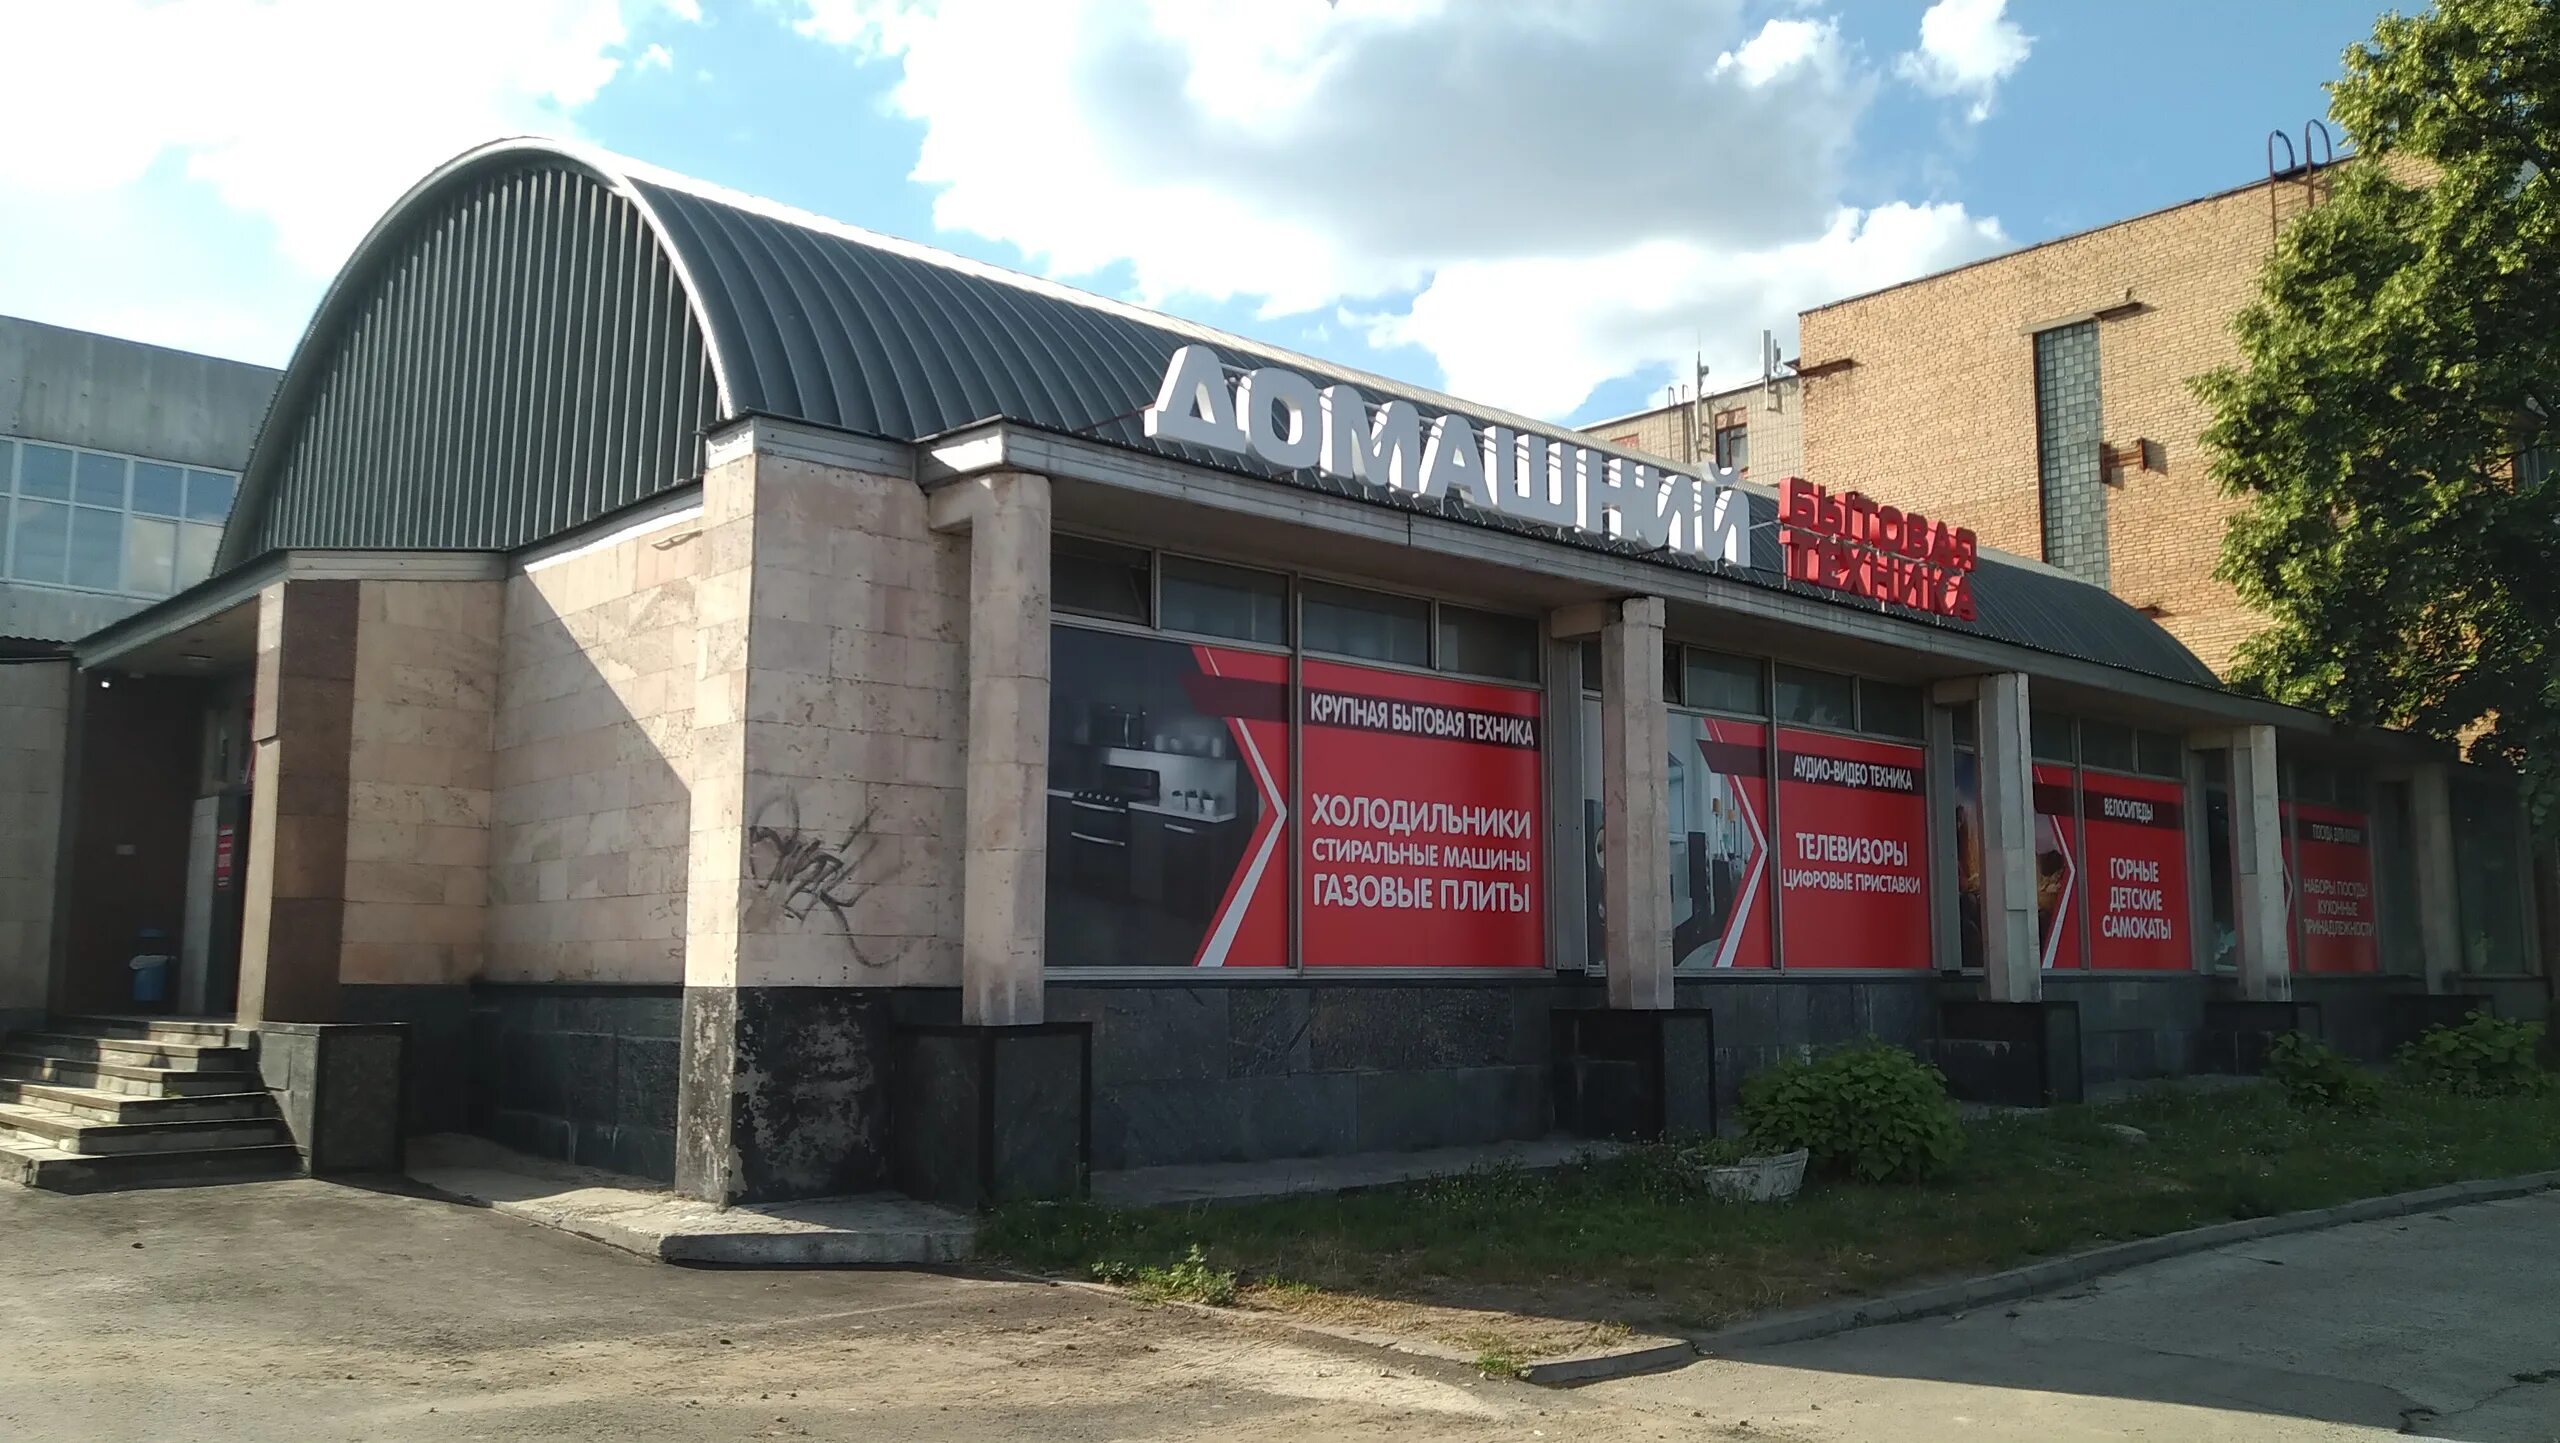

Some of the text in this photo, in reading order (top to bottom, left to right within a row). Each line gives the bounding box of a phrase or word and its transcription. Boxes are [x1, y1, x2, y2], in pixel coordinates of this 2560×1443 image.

[1145, 344, 1750, 568] ДОМАШНИЙ
[1778, 477, 1977, 572] БЫТОВАЯ
[1778, 529, 1977, 621] ТЕХНИКА
[1311, 692, 1535, 746] КРУПНАЯ БЫТОВАЯ ТЕХНИКА
[1793, 754, 1913, 791] АУДИО-ВИДЕО ТЕХНИКА
[1311, 793, 1531, 839] ХОЛОДИЛЬНИКИ
[2104, 797, 2154, 823] ВЕЛОСИПЕДЫ
[1312, 838, 1531, 872] СТИРАЛЬНЫЕ МАШИНЫ
[1795, 832, 1908, 867] ТЕЛЕВИЗОРЫ
[1783, 868, 1921, 894] ЦИФРОВЫЕ ПРИСТАВКИ
[2110, 857, 2159, 883] ГОРНЫЕ
[1313, 873, 1530, 913] ГАЗОВЫЕ ПЛИТЫ
[2109, 886, 2163, 913] ДЕТСКИЕ
[2102, 915, 2172, 940] САМОКАТЫ
